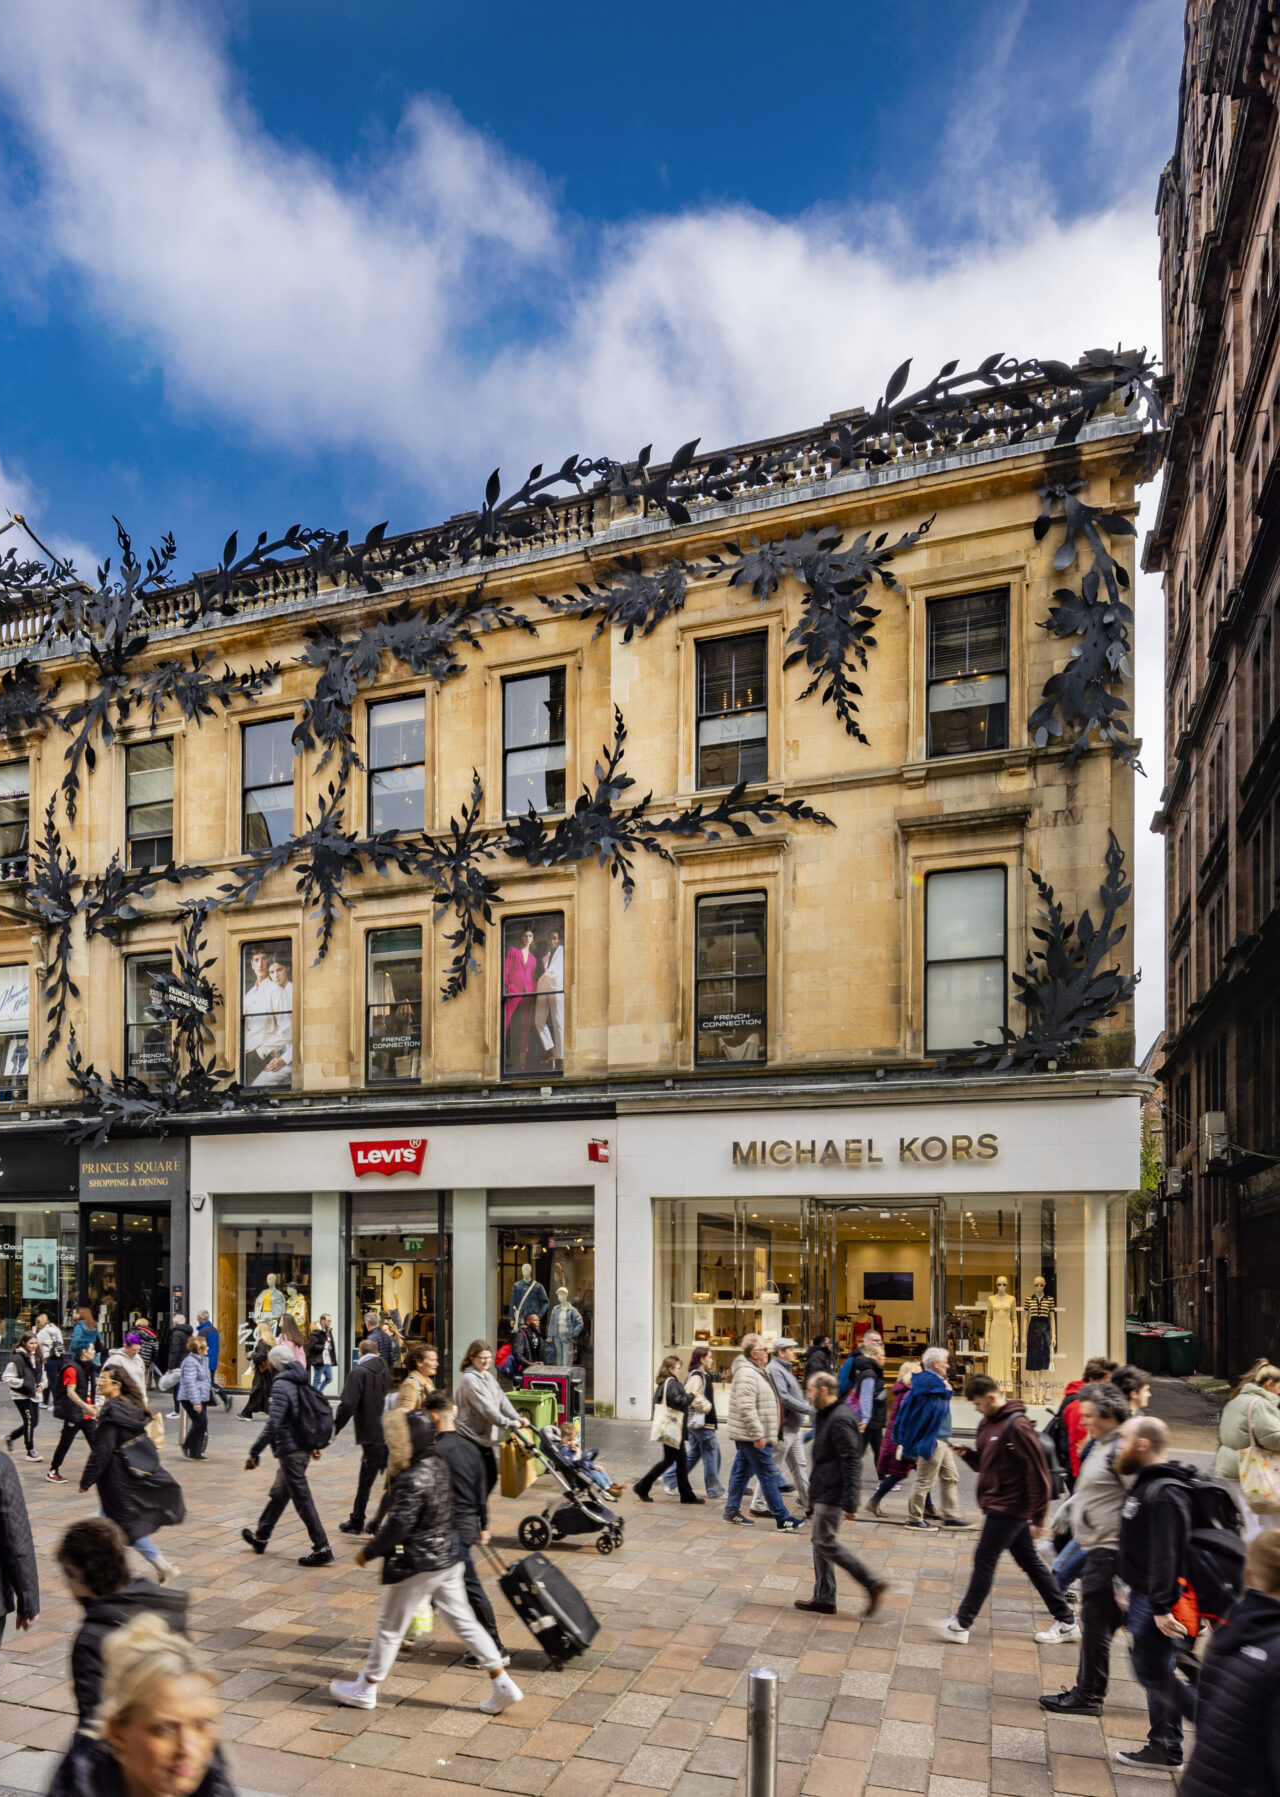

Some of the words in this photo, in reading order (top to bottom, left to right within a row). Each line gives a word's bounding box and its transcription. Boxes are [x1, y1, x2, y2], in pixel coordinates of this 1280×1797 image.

[168, 986, 190, 1000] PRINCES
[189, 994, 209, 1007] SQUARE
[168, 993, 192, 1008] SHOPPING
[713, 1013, 750, 1021] FRENCH
[702, 1019, 762, 1028] CONNECTION
[372, 1041, 421, 1049] CONNECTION
[131, 1057, 172, 1065] CONNECTION
[731, 1138, 884, 1166] MICHAEL
[898, 1133, 1000, 1162] KORS
[81, 1162, 130, 1174] PRINCES
[134, 1160, 181, 1174] SQUARE
[88, 1178, 129, 1187] SHOPPING
[130, 1178, 136, 1187] &
[138, 1178, 169, 1186] DINING
[1039, 1381, 1065, 1389] KORS
